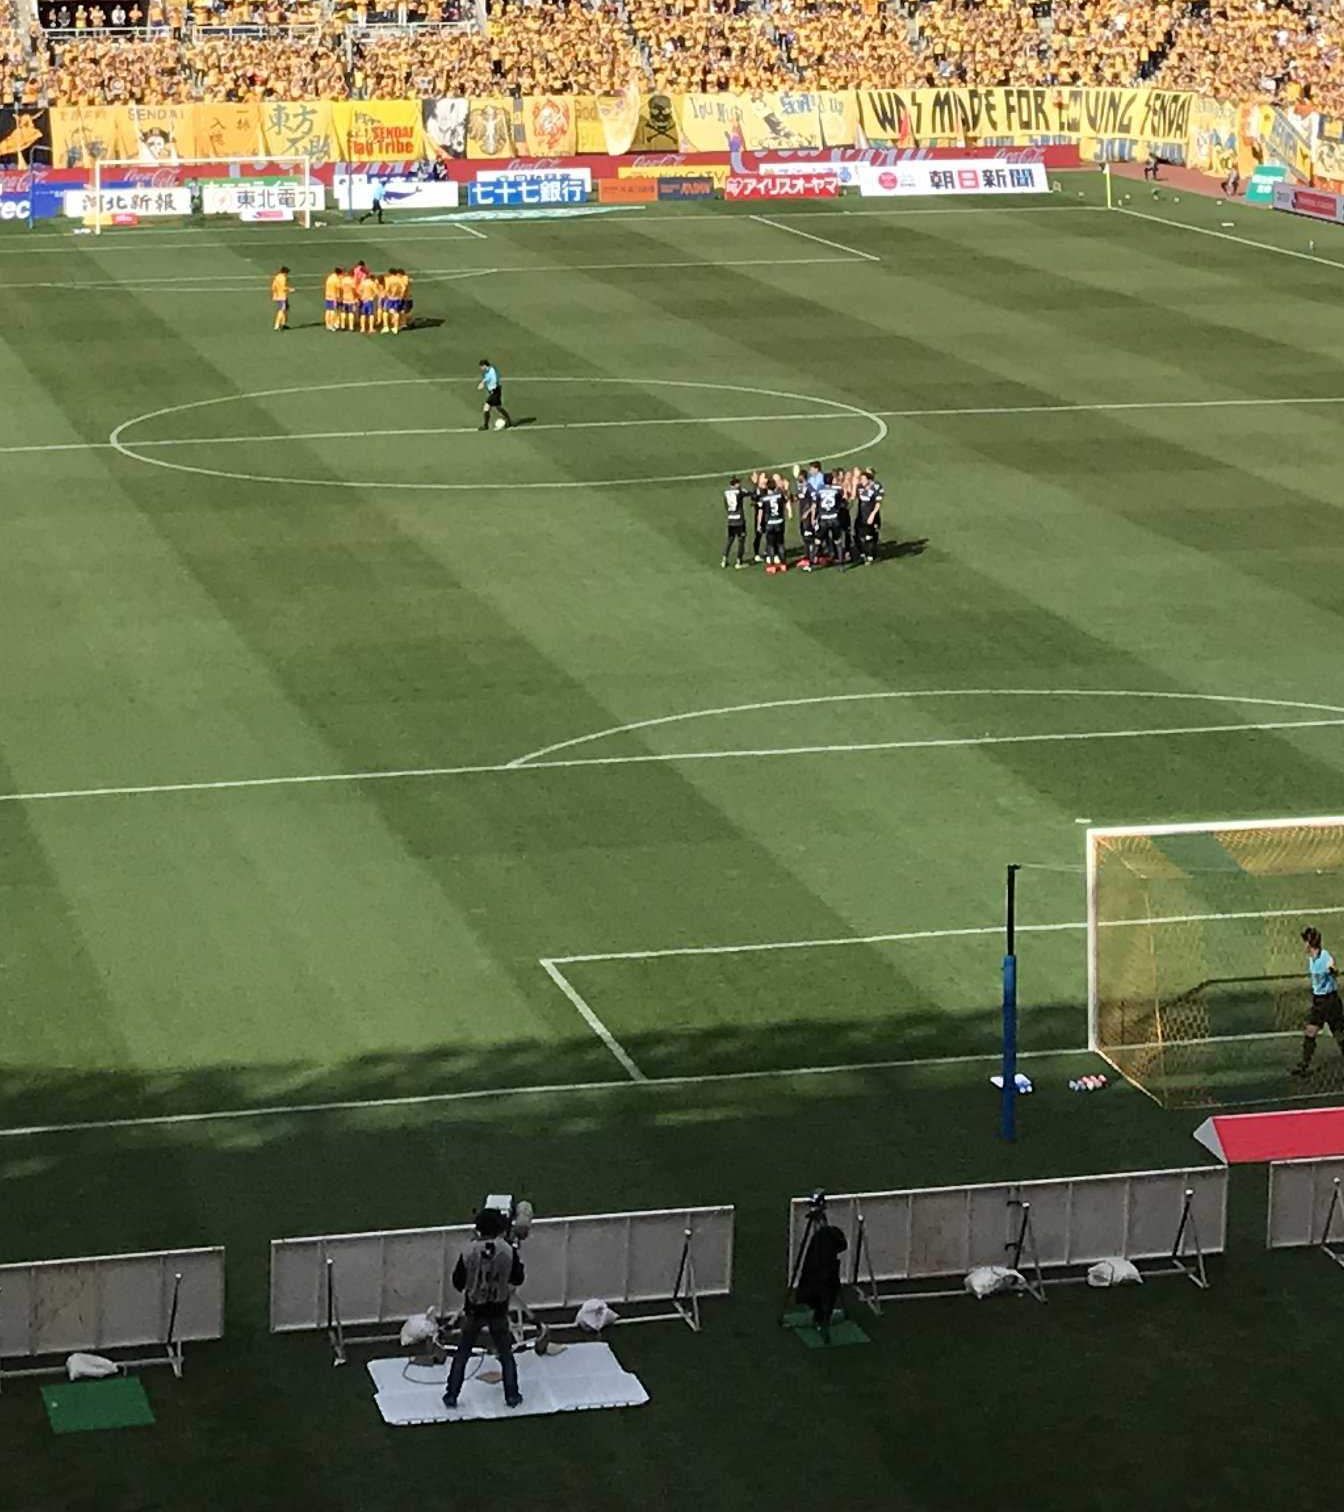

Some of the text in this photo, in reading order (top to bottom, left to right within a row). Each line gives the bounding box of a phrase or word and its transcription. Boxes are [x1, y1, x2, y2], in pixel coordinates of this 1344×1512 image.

[1006, 89, 1050, 131] FOR
[742, 177, 839, 196] アイリスオーヤマ
[929, 168, 1035, 189] 朝日新聞
[236, 190, 317, 209] 東北電力
[471, 182, 583, 205] 七十七銀行
